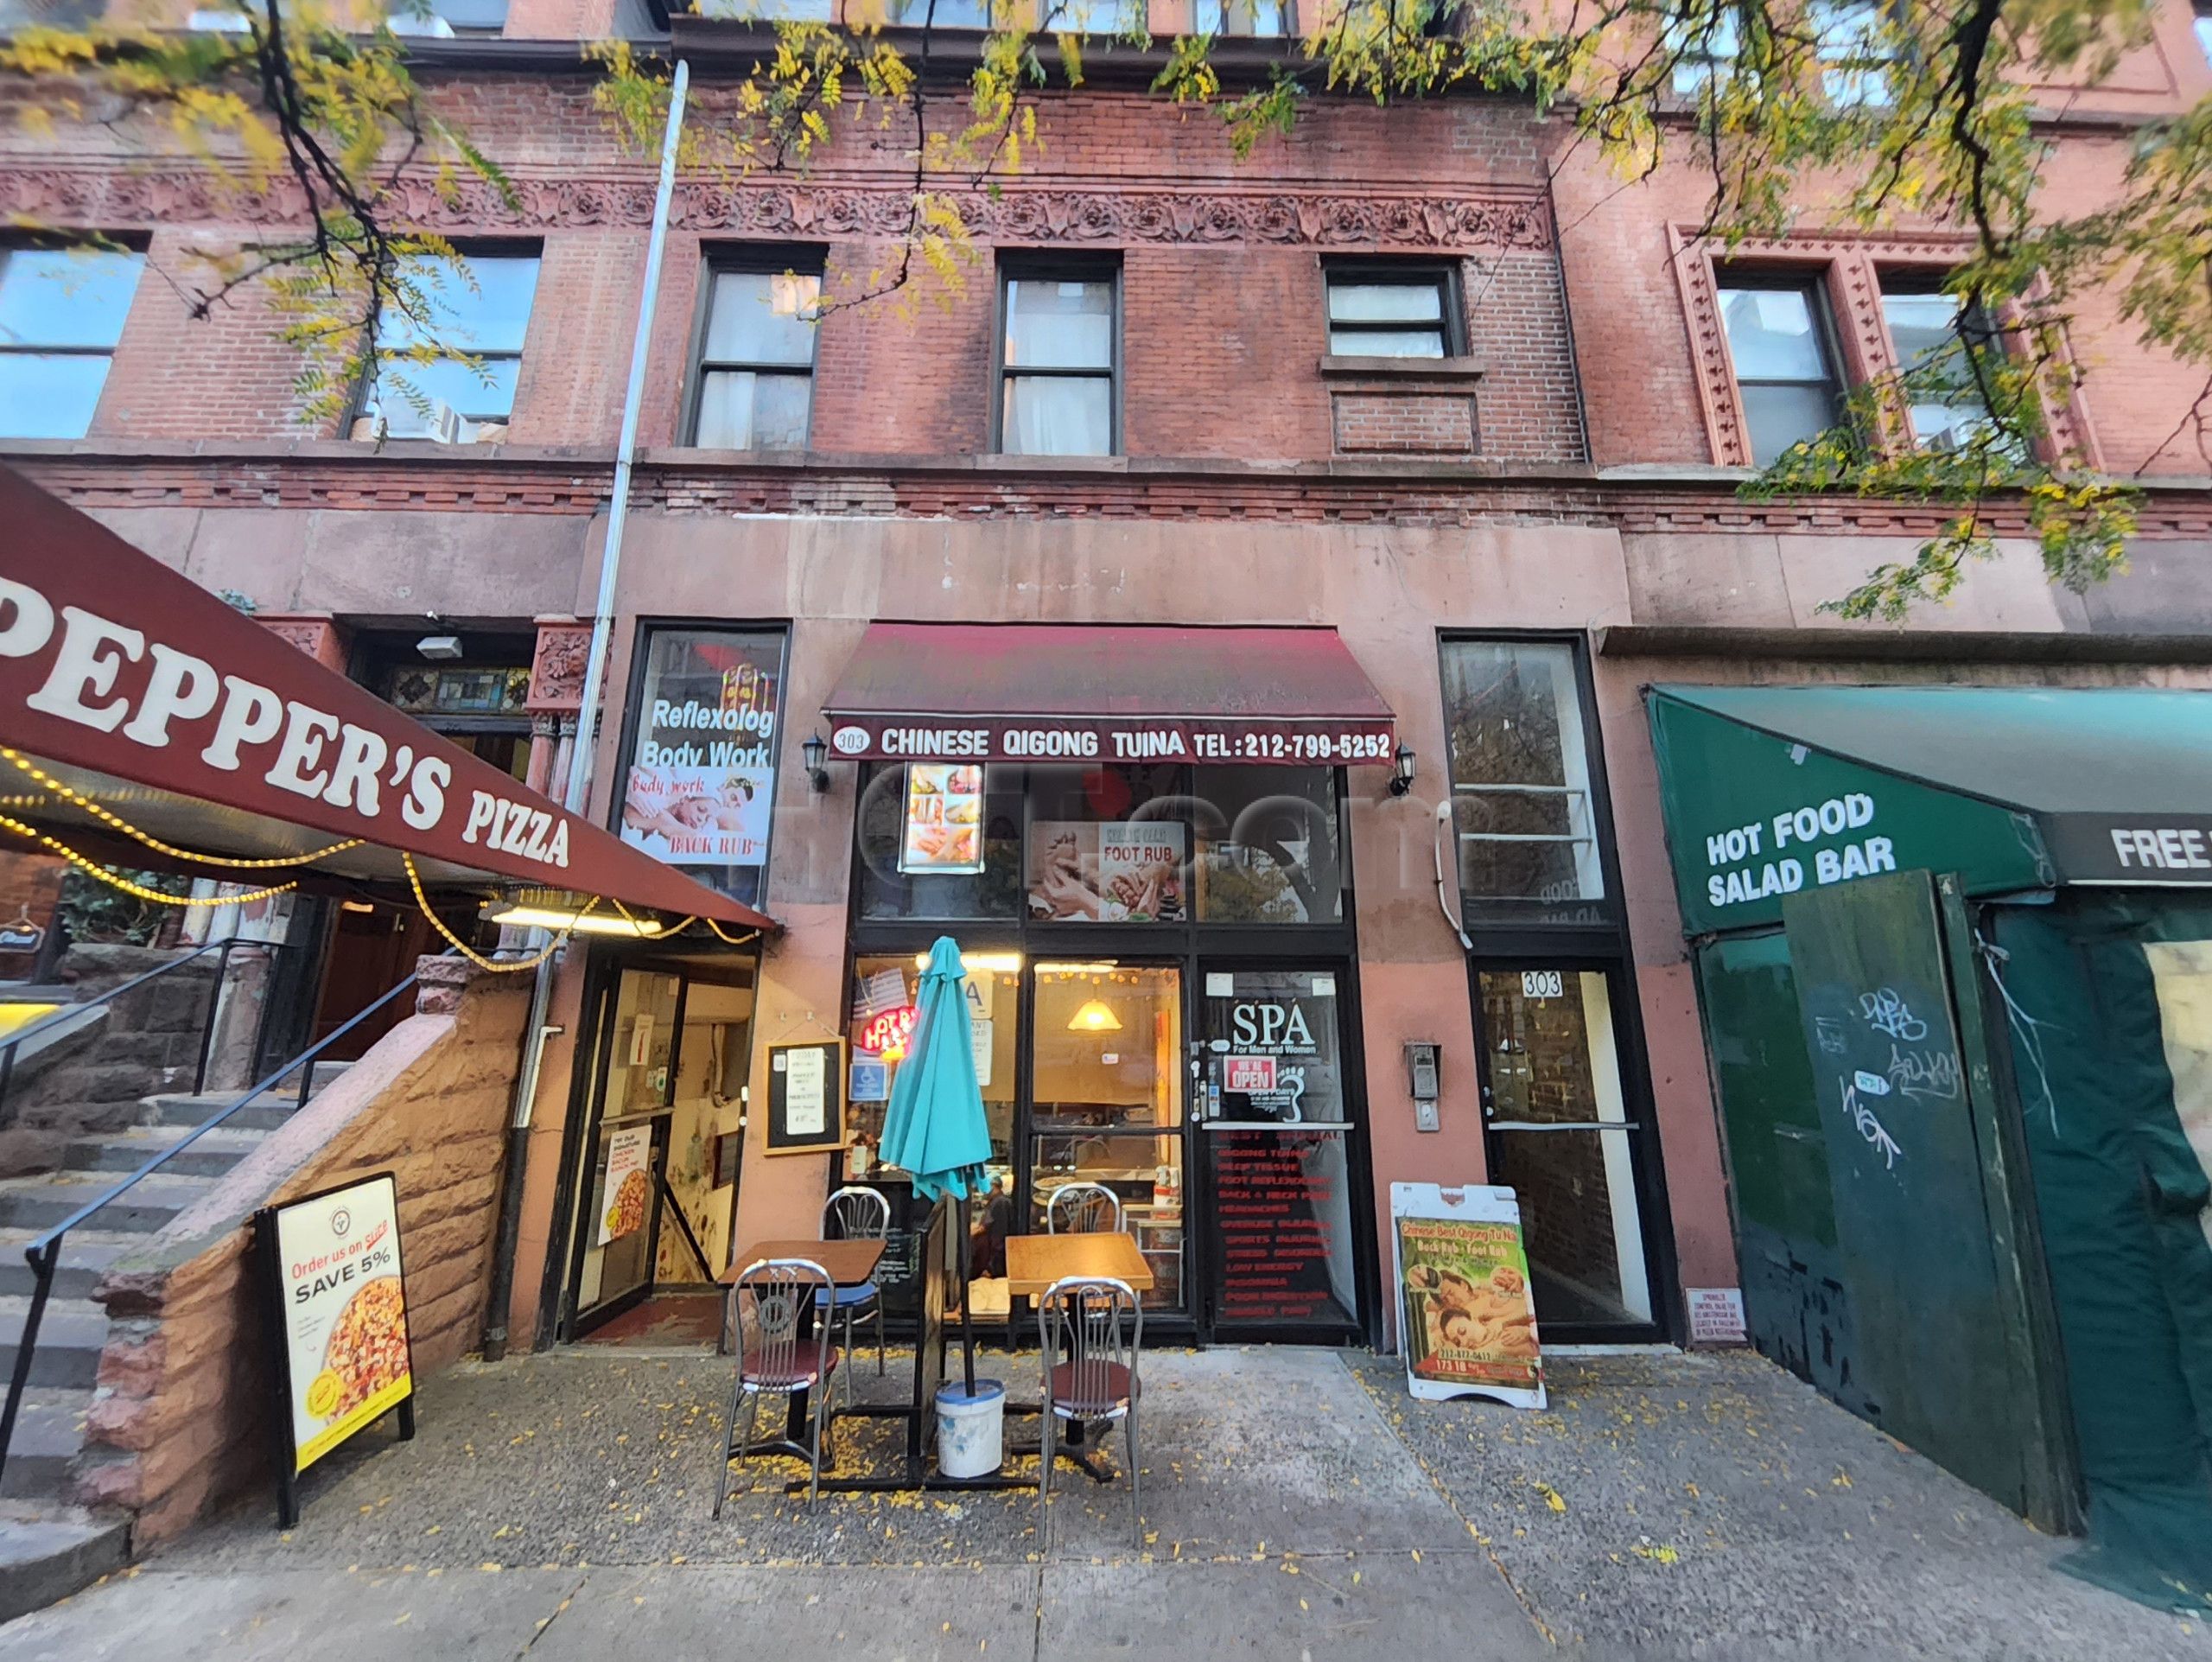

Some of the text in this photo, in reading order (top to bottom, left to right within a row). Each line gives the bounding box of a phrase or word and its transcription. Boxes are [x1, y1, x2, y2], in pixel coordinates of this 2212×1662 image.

[641, 741, 770, 767] Body Work
[838, 733, 864, 749] 303
[881, 729, 990, 755] CHINESE
[1003, 730, 1098, 755] QIGONG
[1111, 731, 1185, 757] TUINA
[462, 790, 569, 868] PIZZA
[671, 837, 753, 854] BACK RUB
[1707, 793, 1874, 866] HOT FOOD
[1104, 847, 1172, 862] FOOT RUB
[2110, 829, 2211, 868] FREE
[1708, 837, 1897, 907] SALAD BAR
[1524, 971, 1560, 995] 303
[1233, 1004, 1315, 1046] SPA
[1233, 1046, 1248, 1054] For
[1232, 1071, 1269, 1088] OPEN
[292, 1254, 329, 1279] Order
[332, 1248, 346, 1263] us
[349, 1241, 363, 1255] on
[296, 1246, 391, 1303] SAVE 5%
